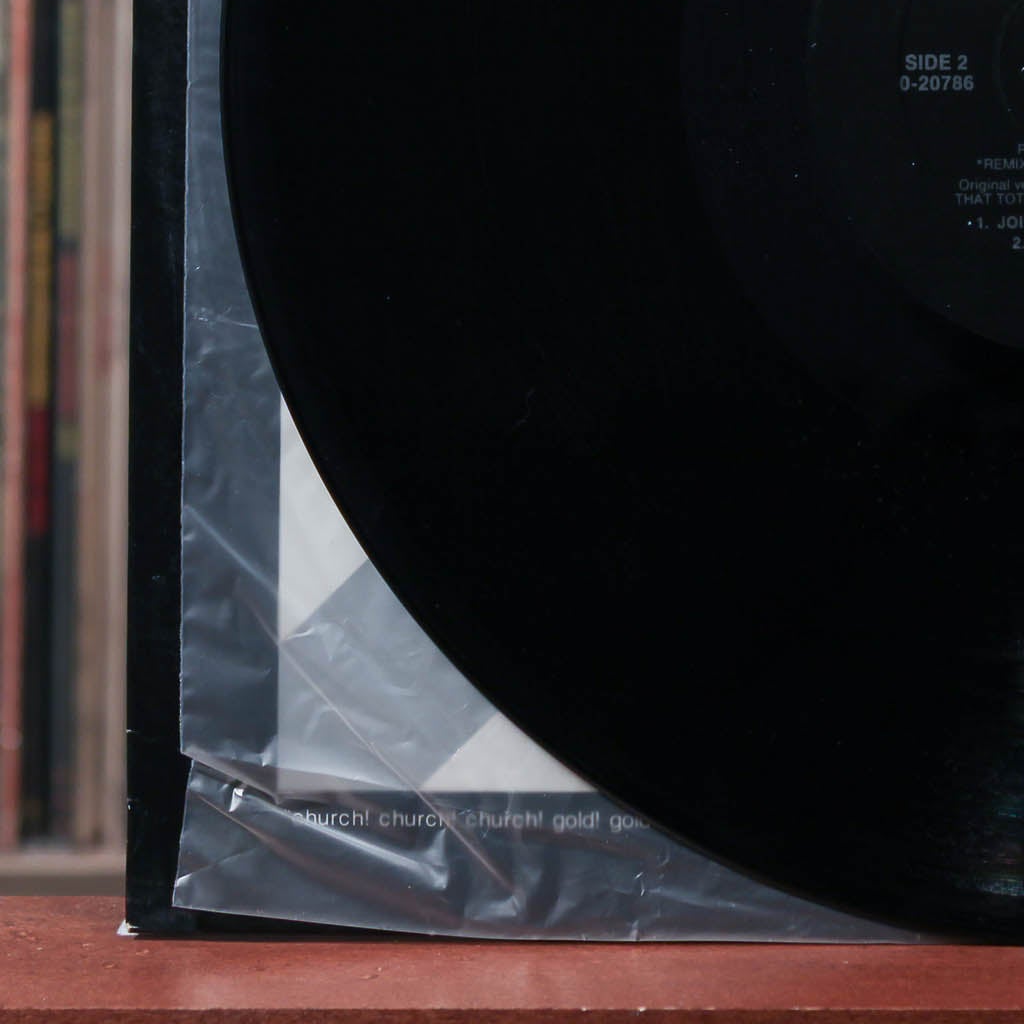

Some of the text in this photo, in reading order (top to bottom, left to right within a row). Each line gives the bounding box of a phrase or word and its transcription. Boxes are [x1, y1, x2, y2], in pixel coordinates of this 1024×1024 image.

[905, 54, 968, 71] SIDE 2
[900, 75, 974, 92] 0-20786
[959, 178, 1011, 193] Original
[955, 192, 992, 206] THAT
[976, 216, 990, 229] 1.
[1012, 236, 1024, 250] 2.
[465, 810, 543, 828] church!
[552, 810, 600, 834] gold!
